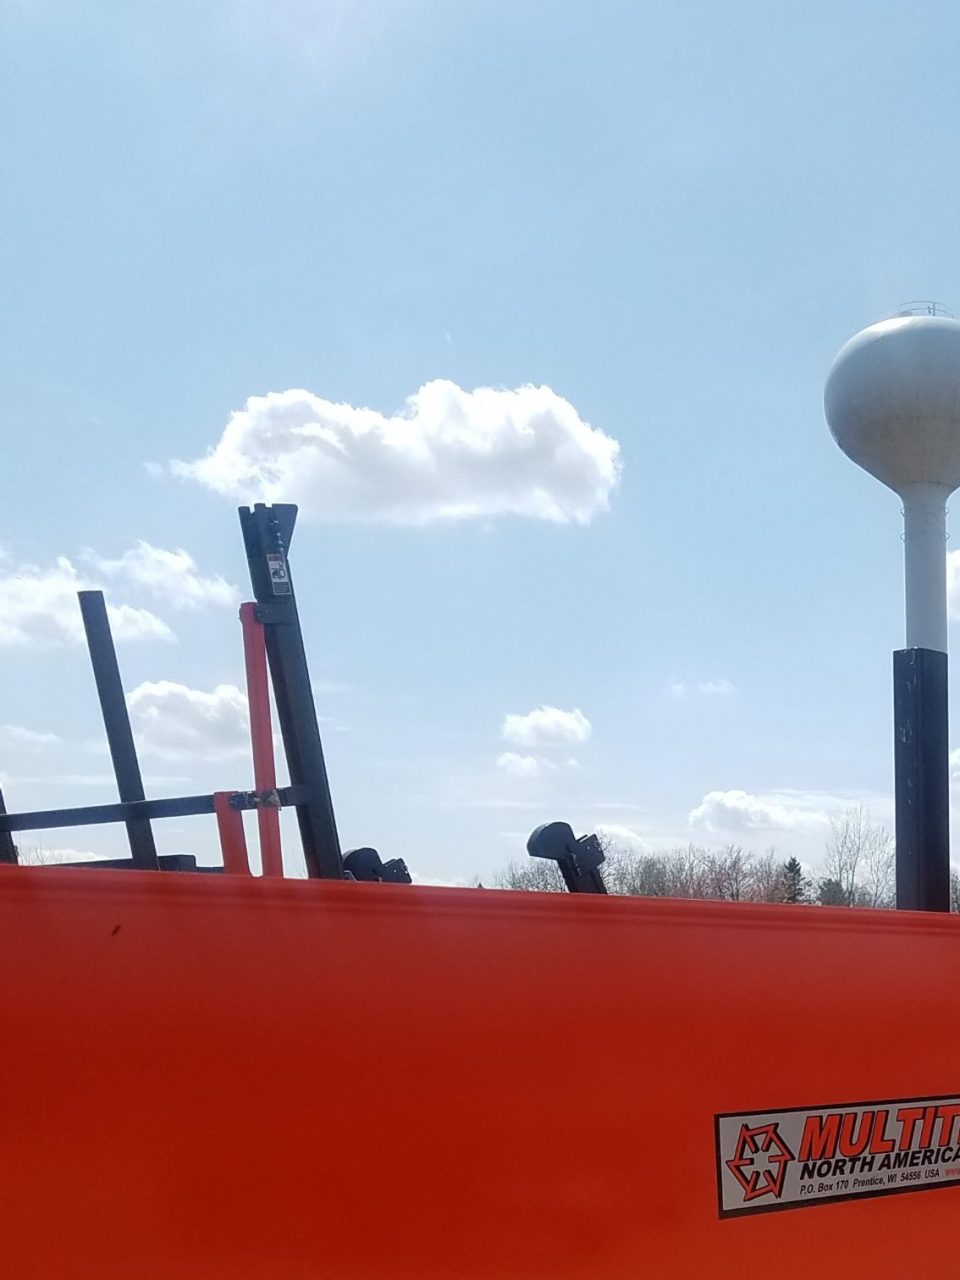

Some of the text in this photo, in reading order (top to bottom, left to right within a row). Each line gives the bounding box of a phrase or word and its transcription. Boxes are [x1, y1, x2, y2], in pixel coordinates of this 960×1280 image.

[799, 1156, 875, 1180] NORTH
[800, 1183, 815, 1195] P.O.
[818, 1182, 833, 1193] Box
[836, 1180, 849, 1190] 170
[853, 1176, 885, 1188] Prentice,
[887, 1173, 897, 1183] WI
[900, 1170, 921, 1182] 54556
[925, 1168, 940, 1179] USA
